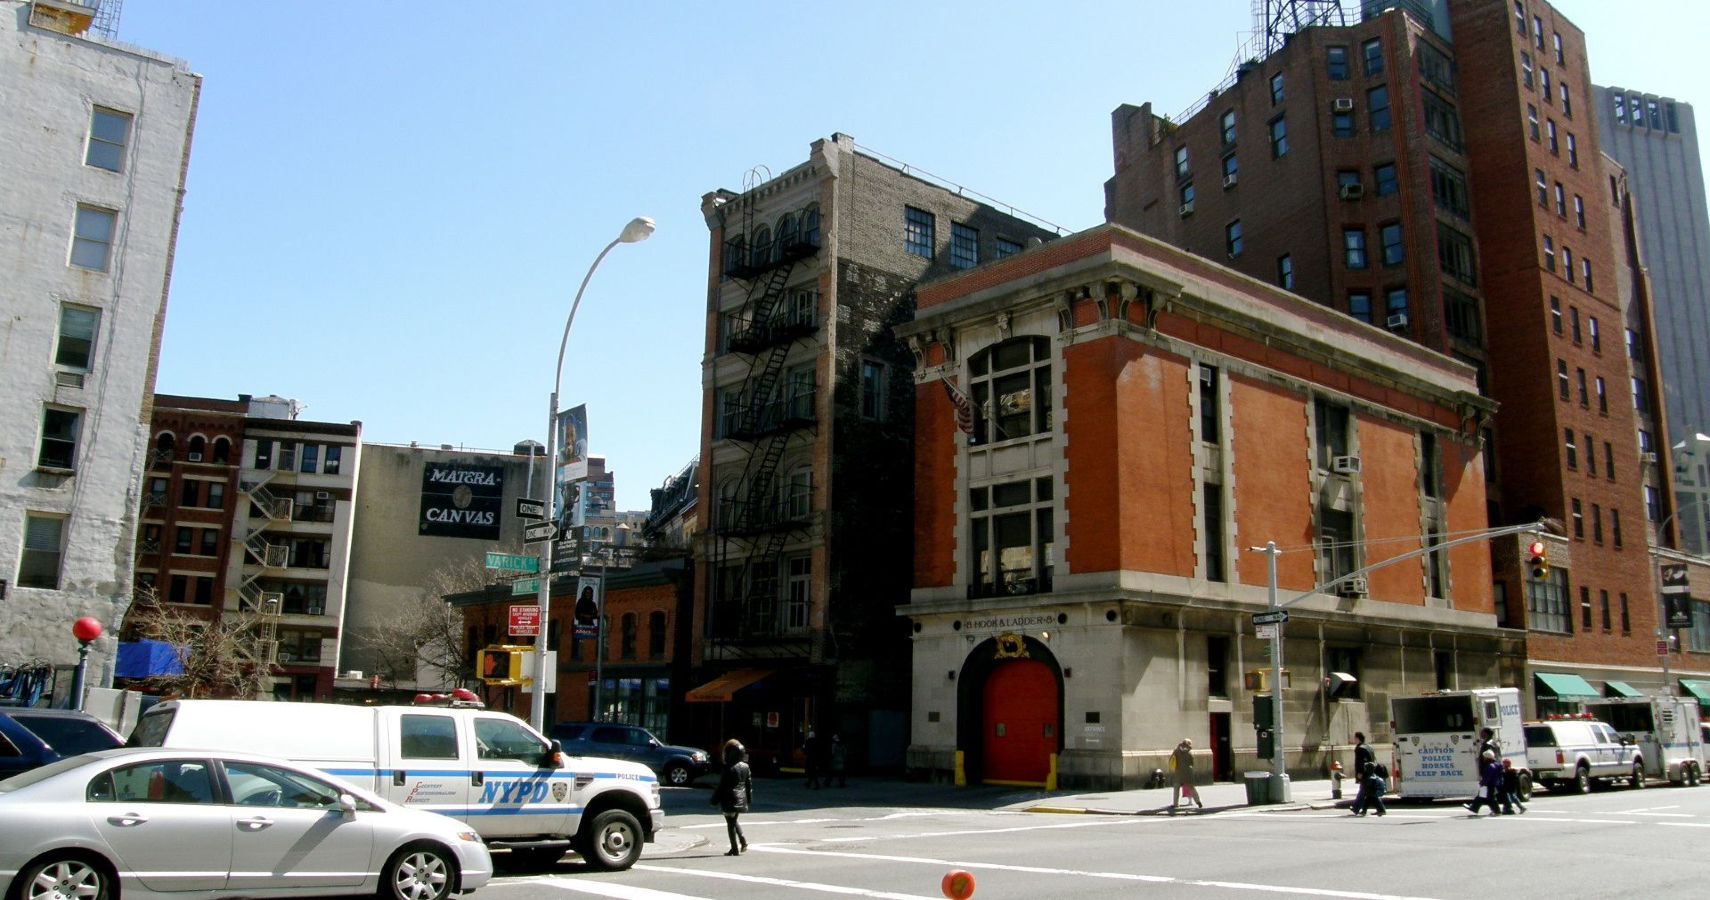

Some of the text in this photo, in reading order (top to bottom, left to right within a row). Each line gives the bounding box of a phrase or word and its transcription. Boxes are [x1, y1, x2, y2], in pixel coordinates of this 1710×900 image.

[430, 469, 495, 485] MATERA
[426, 507, 495, 525] CANVAS
[521, 504, 537, 514] ONE
[526, 529, 537, 538] ONE
[488, 554, 528, 569] VARICK
[974, 619, 997, 629] HOOK
[1006, 616, 1044, 627] LADDER
[617, 773, 640, 781] POLICE
[478, 781, 549, 804] NYPD
